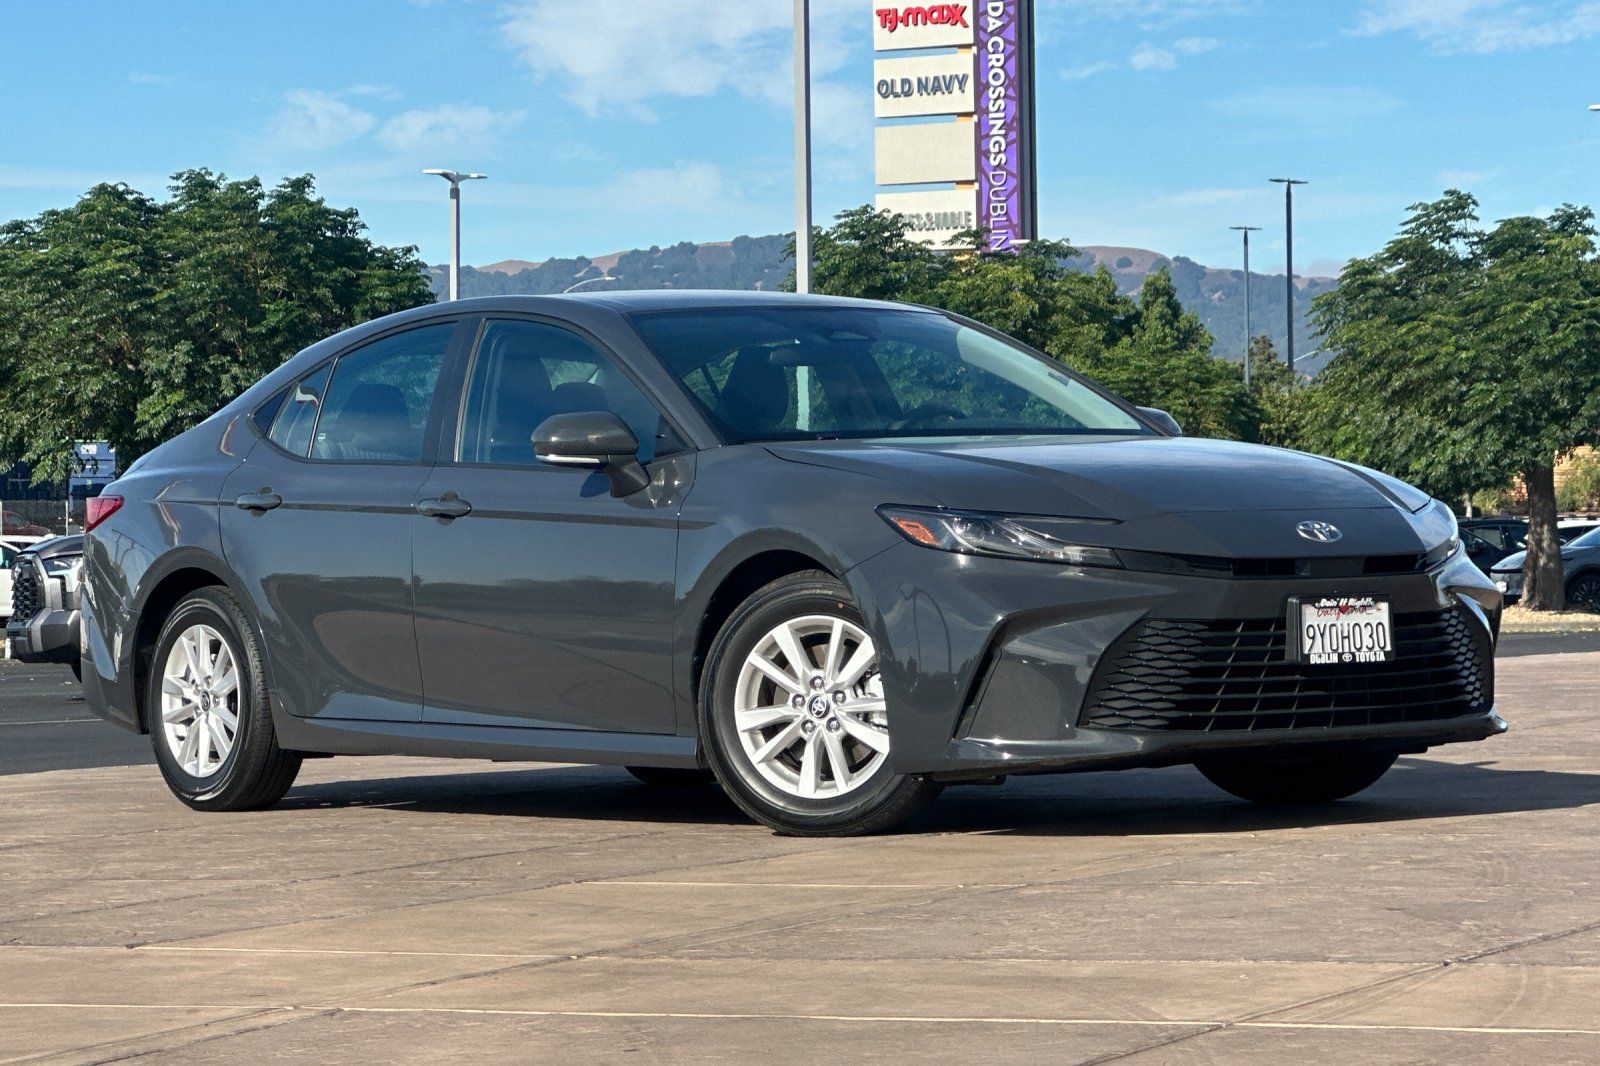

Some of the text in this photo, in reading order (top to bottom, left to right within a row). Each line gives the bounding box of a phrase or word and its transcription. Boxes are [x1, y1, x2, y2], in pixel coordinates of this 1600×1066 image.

[877, 73, 968, 99] OLD NAVY
[987, 36, 1006, 167] CROSSINGS
[990, 171, 1007, 251] DUBLIN
[1309, 651, 1385, 664] DUBLIN TOYOTA
